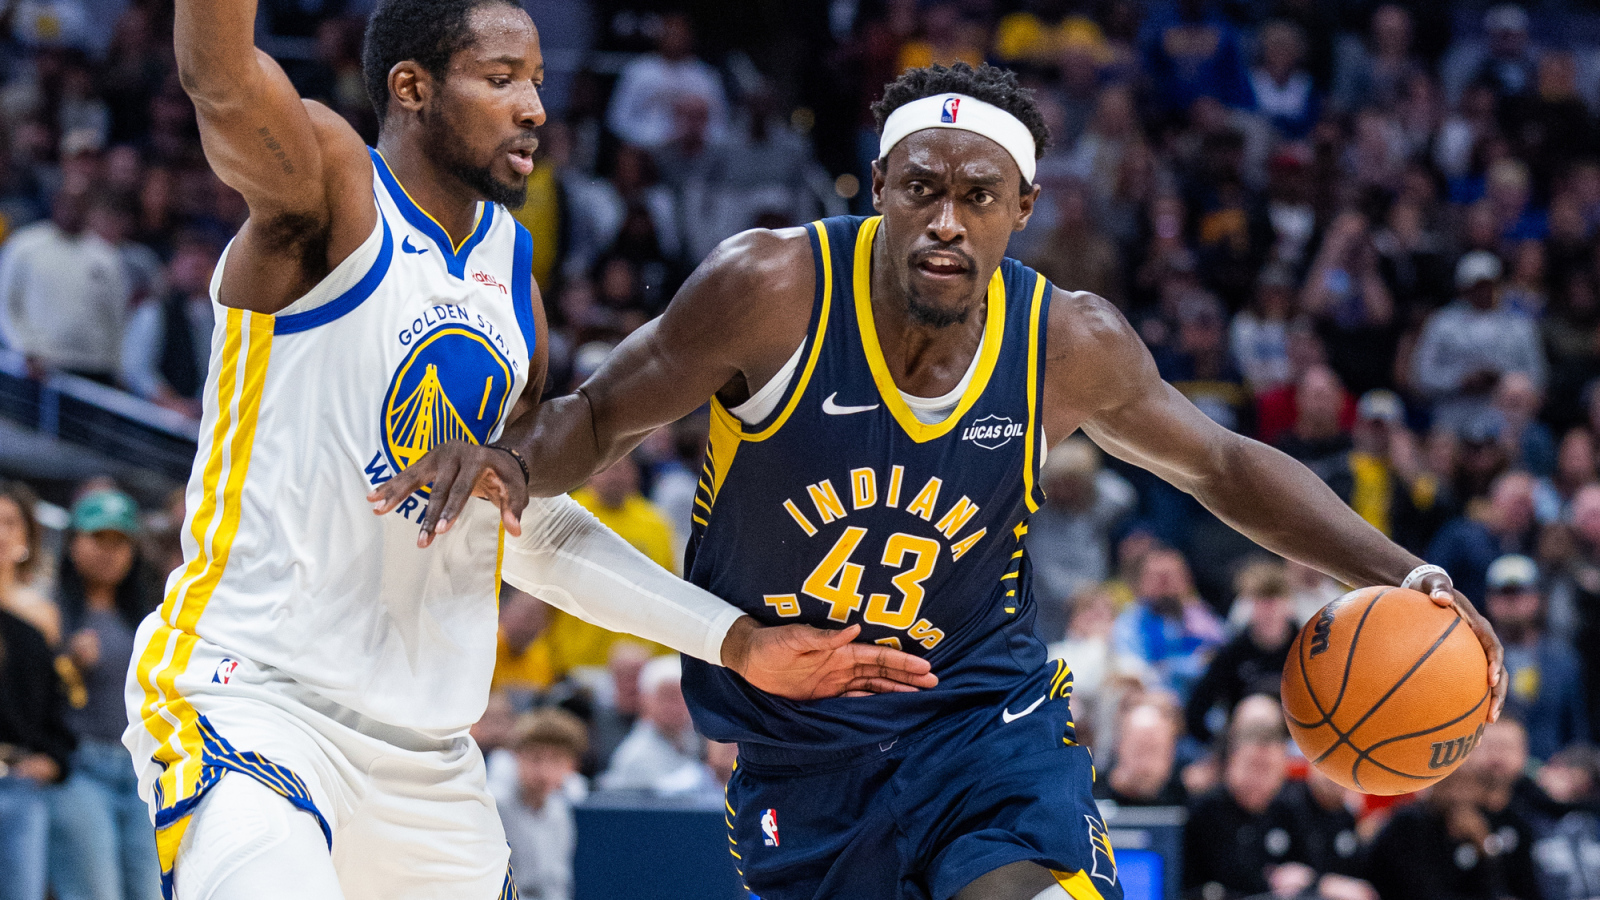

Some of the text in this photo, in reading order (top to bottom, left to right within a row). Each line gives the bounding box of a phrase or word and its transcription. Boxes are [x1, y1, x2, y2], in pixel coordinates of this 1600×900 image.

[398, 303, 470, 346] GOLDEN
[477, 375, 494, 421] 1
[961, 423, 1024, 441] LUCAS OIL
[782, 464, 988, 563] INDIANA
[801, 525, 941, 631] 43
[1428, 722, 1485, 770] Wil
